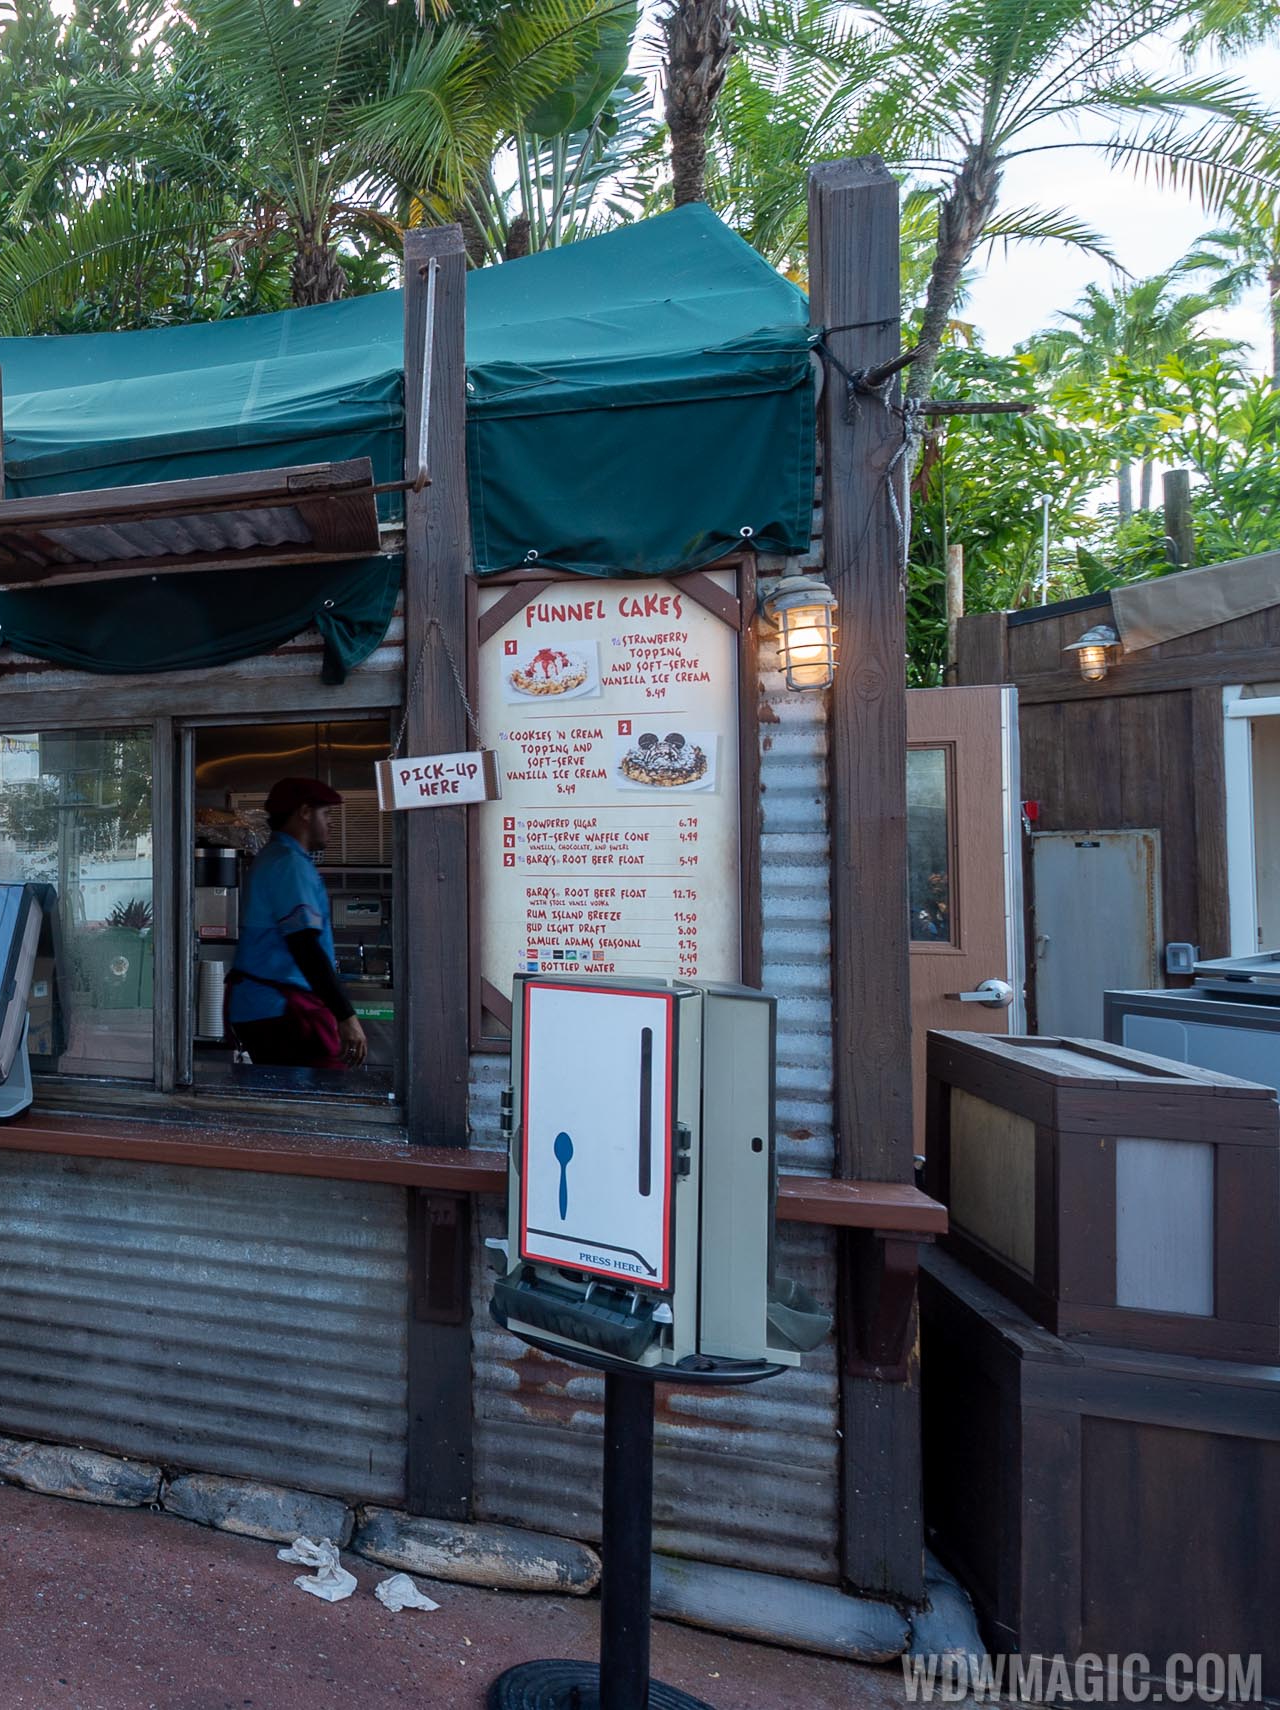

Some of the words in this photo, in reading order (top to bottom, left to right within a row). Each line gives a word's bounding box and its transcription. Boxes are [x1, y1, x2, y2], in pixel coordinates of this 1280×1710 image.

[526, 600, 606, 627] FUNNEL
[618, 593, 682, 619] CAKES
[622, 632, 688, 647] STRAWBERRY
[629, 647, 682, 659] TOPPING
[611, 661, 632, 672] AND
[636, 658, 699, 673] SOFT-SERVE
[601, 675, 646, 686] VANILLA
[651, 673, 670, 684] ICE
[675, 671, 711, 683] CREAM
[509, 730, 551, 742] COOKIES
[571, 728, 603, 739] CREAM
[521, 744, 569, 755] TOPPING
[573, 742, 592, 753] AND
[527, 755, 585, 768] SOFT-SERVE
[399, 762, 478, 786] PICK-UP
[506, 770, 548, 780] VANILLA
[552, 770, 570, 779] ICE
[574, 768, 607, 779] CREAM
[419, 779, 460, 796] HERE
[526, 818, 570, 830] POWDERED
[573, 818, 597, 829] SUGAR
[526, 832, 580, 843] SOFT-SERVE
[585, 832, 620, 843] WAFFLE
[624, 832, 650, 842] CONE
[562, 854, 587, 864] ROOT
[591, 855, 614, 865] BEER
[618, 855, 645, 866] FLOAT
[564, 888, 590, 898] ROOT
[593, 888, 616, 899] BEER
[620, 889, 647, 899] FLOAT
[672, 889, 697, 900] 12.75
[526, 909, 547, 919] RUM
[551, 910, 584, 921] ISLAND
[587, 910, 622, 921] BREEZE
[673, 912, 697, 923] 11.50
[526, 923, 543, 933] BUD
[547, 923, 574, 934] LIGHT
[578, 923, 606, 935] DRAFT
[526, 936, 560, 946] SAMUEL
[564, 937, 594, 948] ADAMS
[598, 938, 641, 948] SEASONAL
[540, 962, 580, 972] BOTTLED
[584, 963, 615, 973] WATER
[579, 1252, 611, 1267] PRESS
[613, 1261, 642, 1273] HERE
